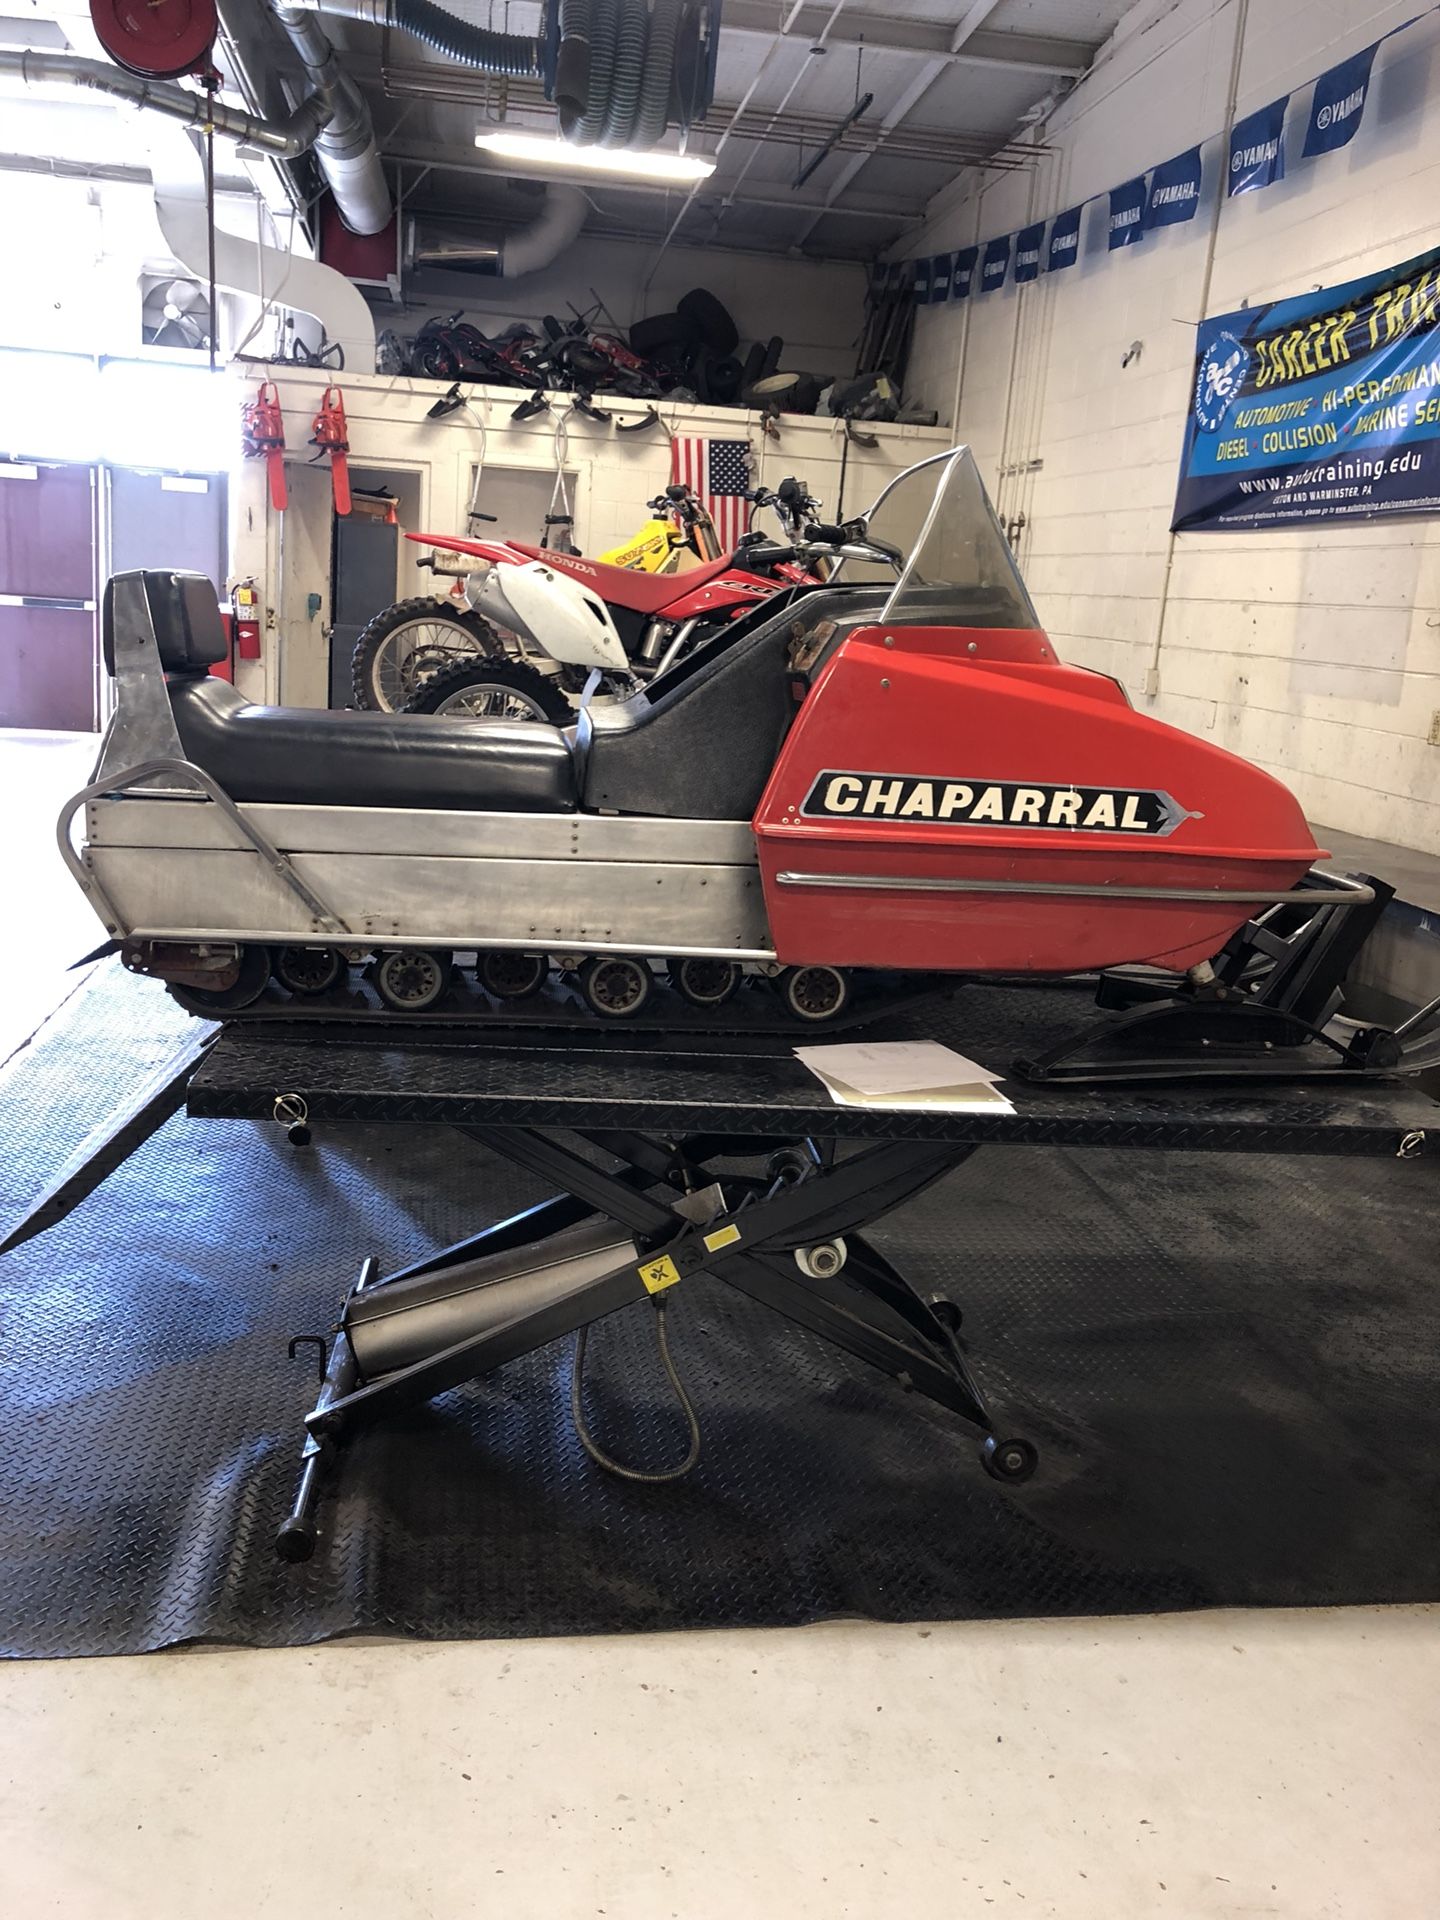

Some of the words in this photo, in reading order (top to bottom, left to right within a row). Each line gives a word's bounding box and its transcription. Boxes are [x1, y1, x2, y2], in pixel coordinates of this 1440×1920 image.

[1243, 138, 1279, 167] YAMAH
[1159, 181, 1194, 204] YAMAHA
[1255, 309, 1357, 388] CAREER
[1234, 397, 1313, 429] AUTOMOTIVE
[1216, 437, 1250, 461] DIESEL
[1262, 422, 1337, 454] COLLISION
[1239, 451, 1421, 494] www.autotraining.edu
[1293, 492, 1308, 503] AND
[1362, 485, 1372, 496] PA
[537, 551, 598, 577] HONDA
[823, 775, 1150, 830] CHAPARRAL
